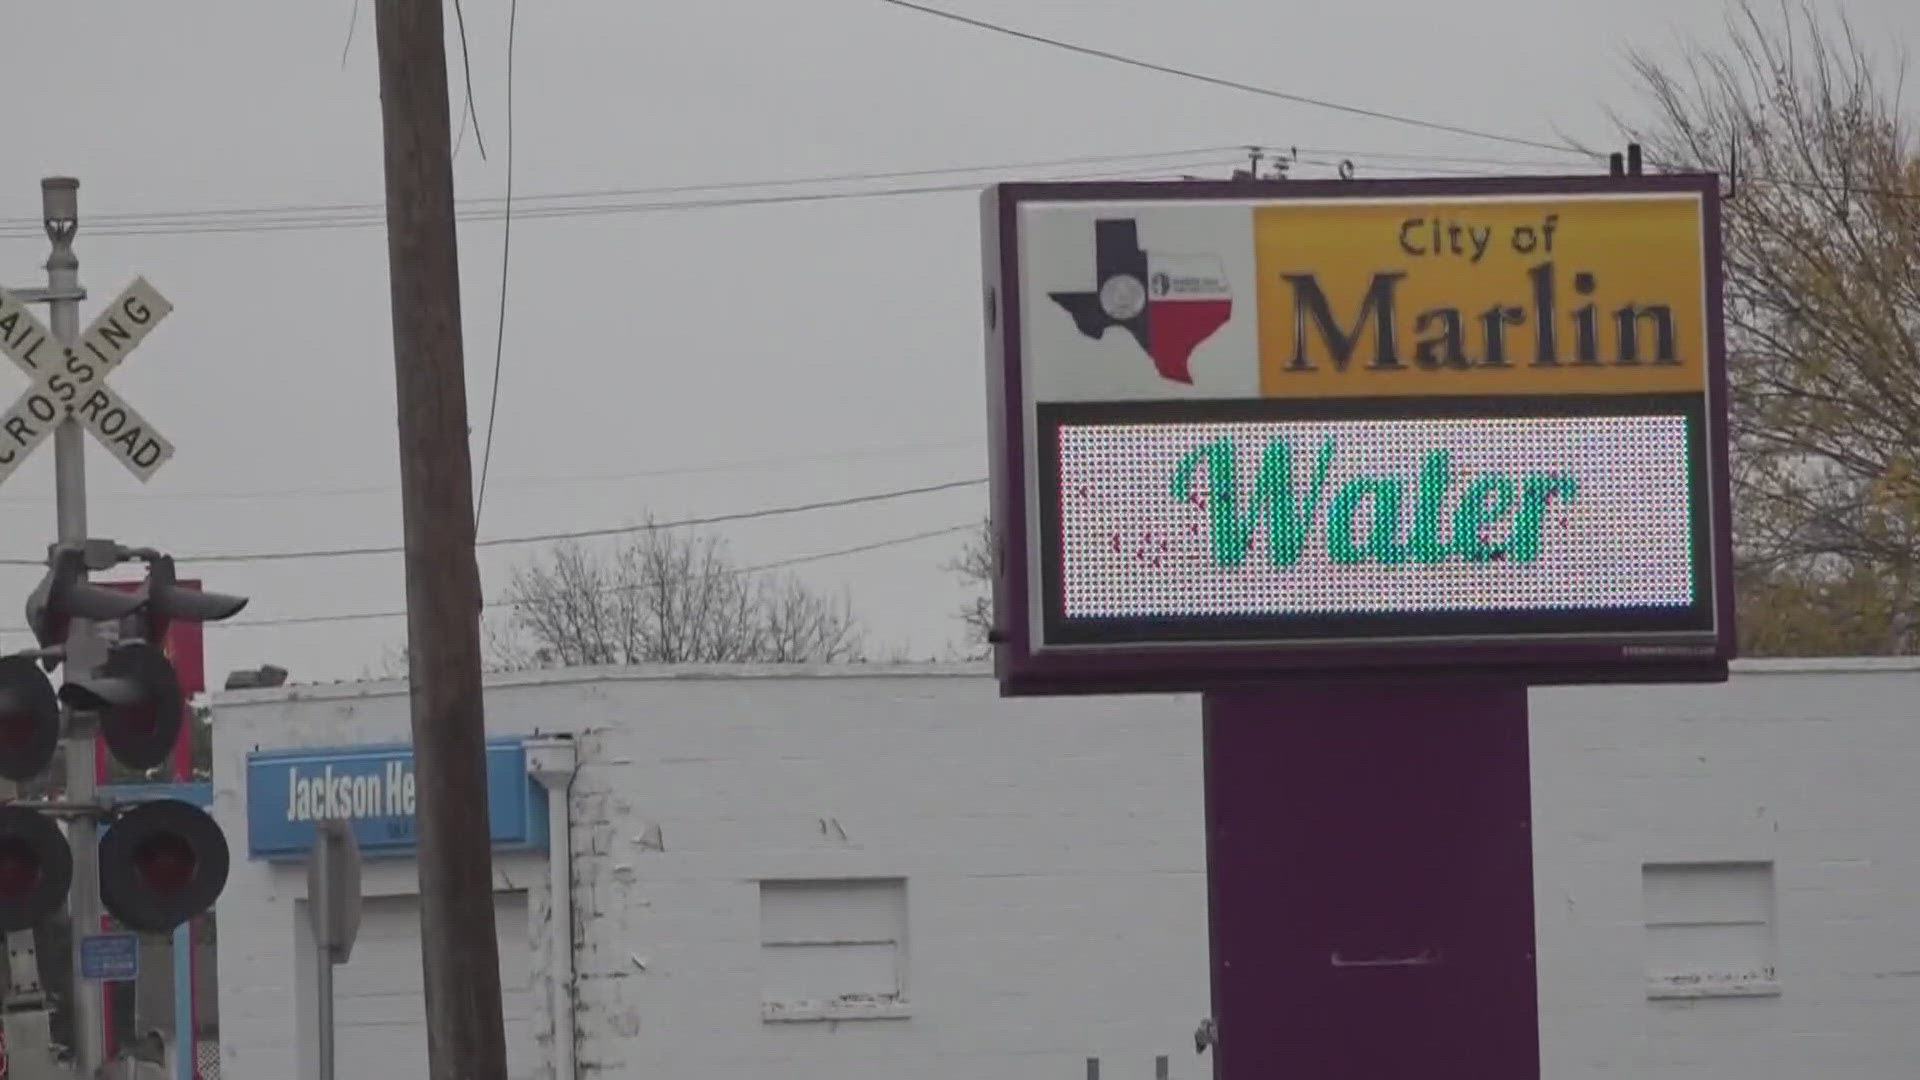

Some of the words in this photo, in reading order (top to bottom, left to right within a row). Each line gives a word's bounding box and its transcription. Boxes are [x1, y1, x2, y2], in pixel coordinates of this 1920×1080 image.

[1399, 217, 1491, 263] City
[1511, 214, 1559, 253] of
[1279, 261, 1683, 373] Marlin
[0, 297, 45, 369] AIL
[80, 390, 161, 468] ROAD
[1170, 434, 1579, 568] Water
[287, 765, 381, 821] Jackson
